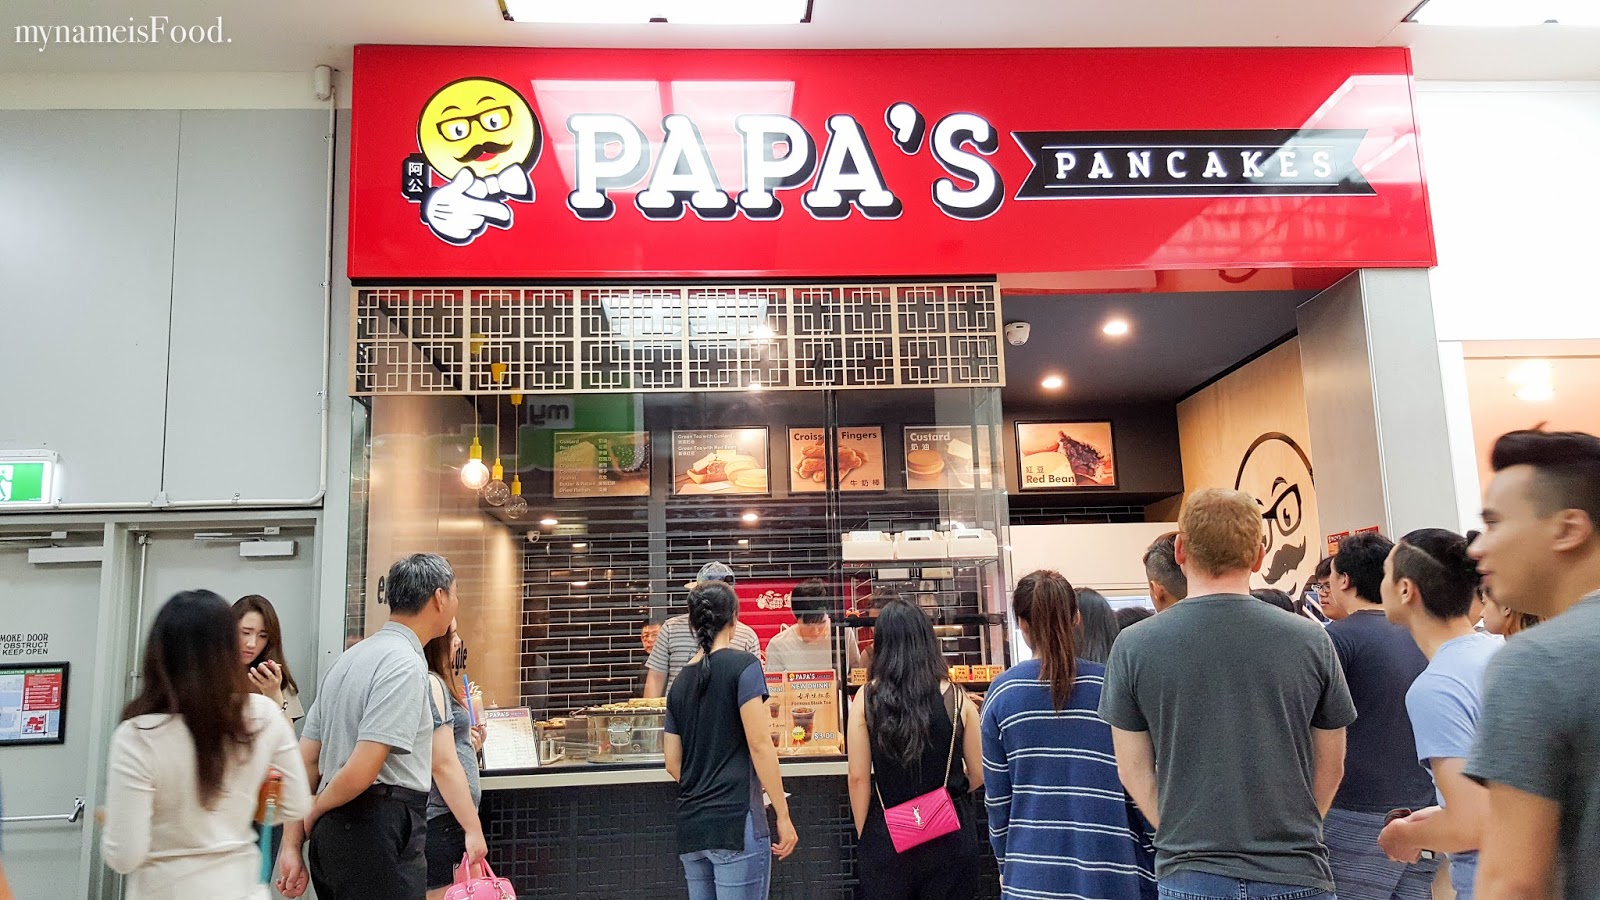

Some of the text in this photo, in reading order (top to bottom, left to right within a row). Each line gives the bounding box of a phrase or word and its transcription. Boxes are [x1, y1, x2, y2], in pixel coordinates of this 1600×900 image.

[567, 101, 1005, 221] PAPA'S
[1054, 150, 1334, 179] PANCAKES
[408, 162, 424, 193] 阿公
[794, 431, 878, 442] Croiss Fingers
[909, 432, 951, 442] Custard
[1026, 474, 1075, 484] Red Bean
[27, 633, 49, 642] DOOR
[2, 648, 24, 656] KEEP
[814, 731, 835, 741] $3.00
